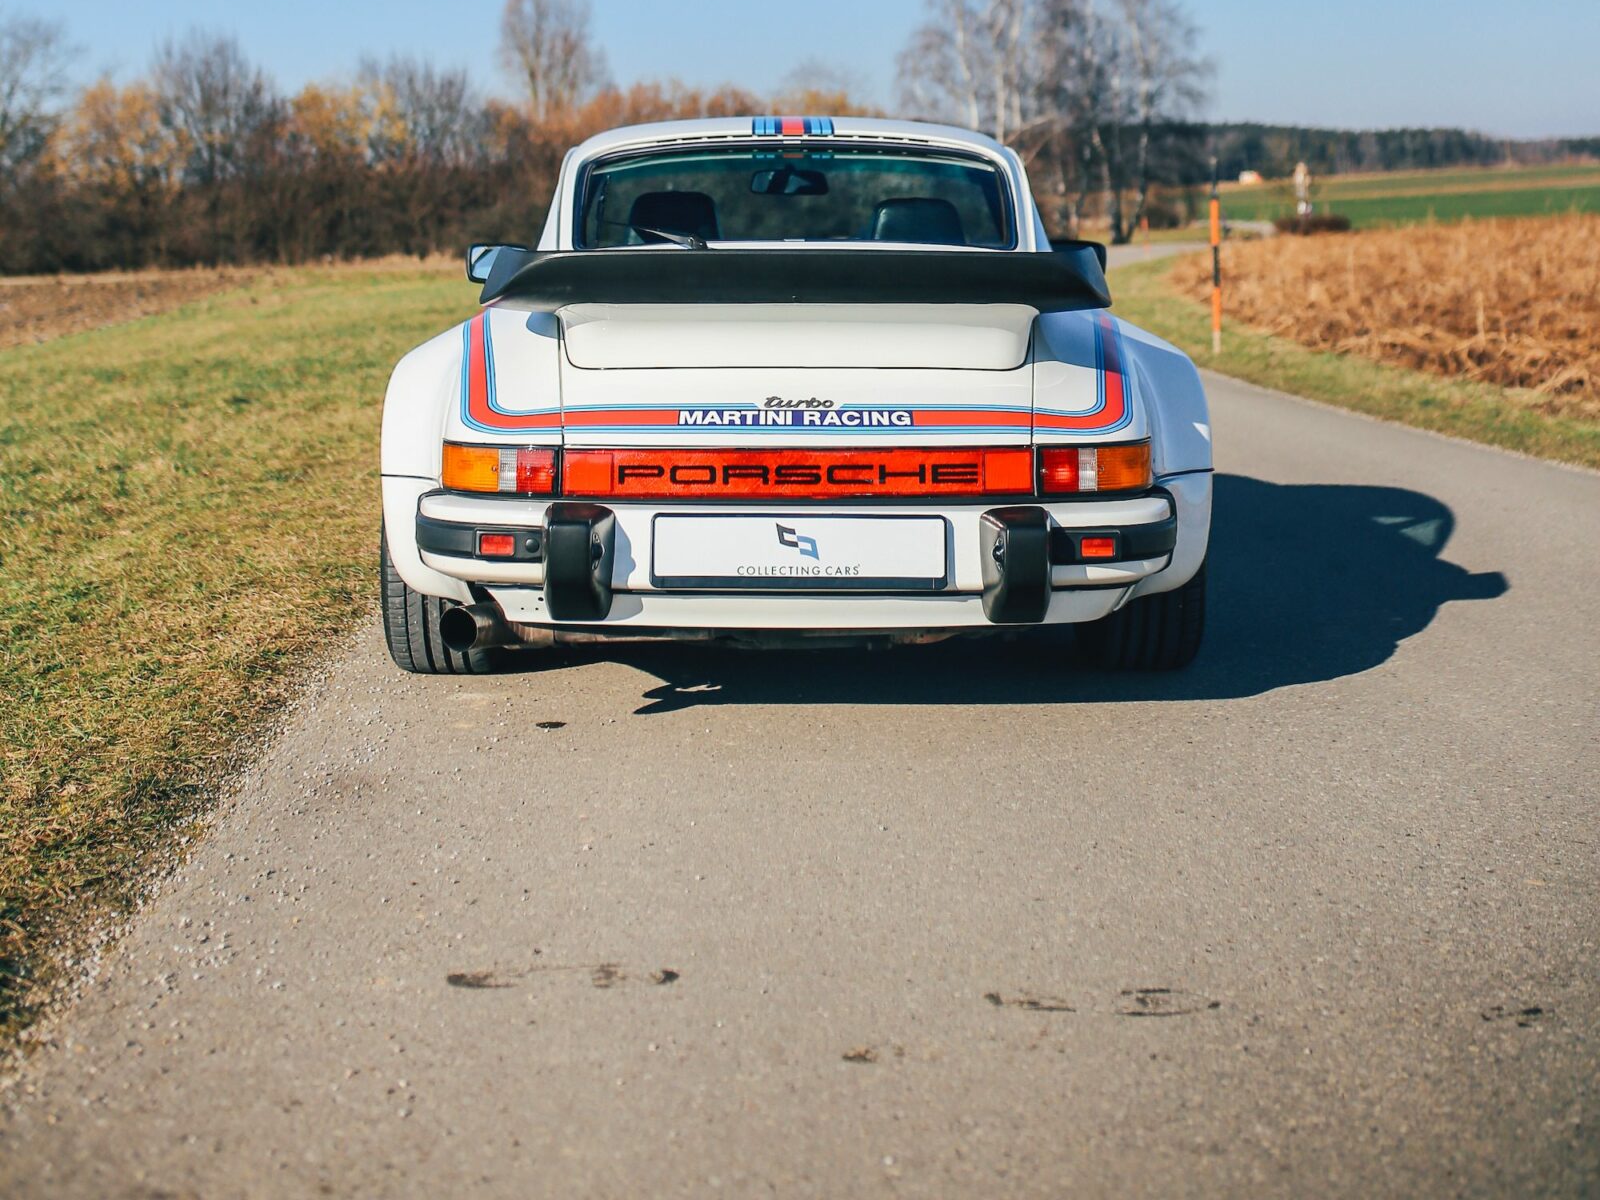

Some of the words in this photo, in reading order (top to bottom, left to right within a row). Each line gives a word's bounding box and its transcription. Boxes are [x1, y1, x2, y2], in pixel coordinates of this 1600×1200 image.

[764, 396, 834, 409] turbo
[679, 410, 793, 425] MARTINI
[803, 411, 912, 426] RACING
[618, 464, 979, 485] PORSCHE
[737, 566, 820, 576] COLLECTING
[825, 566, 859, 576] CARS
